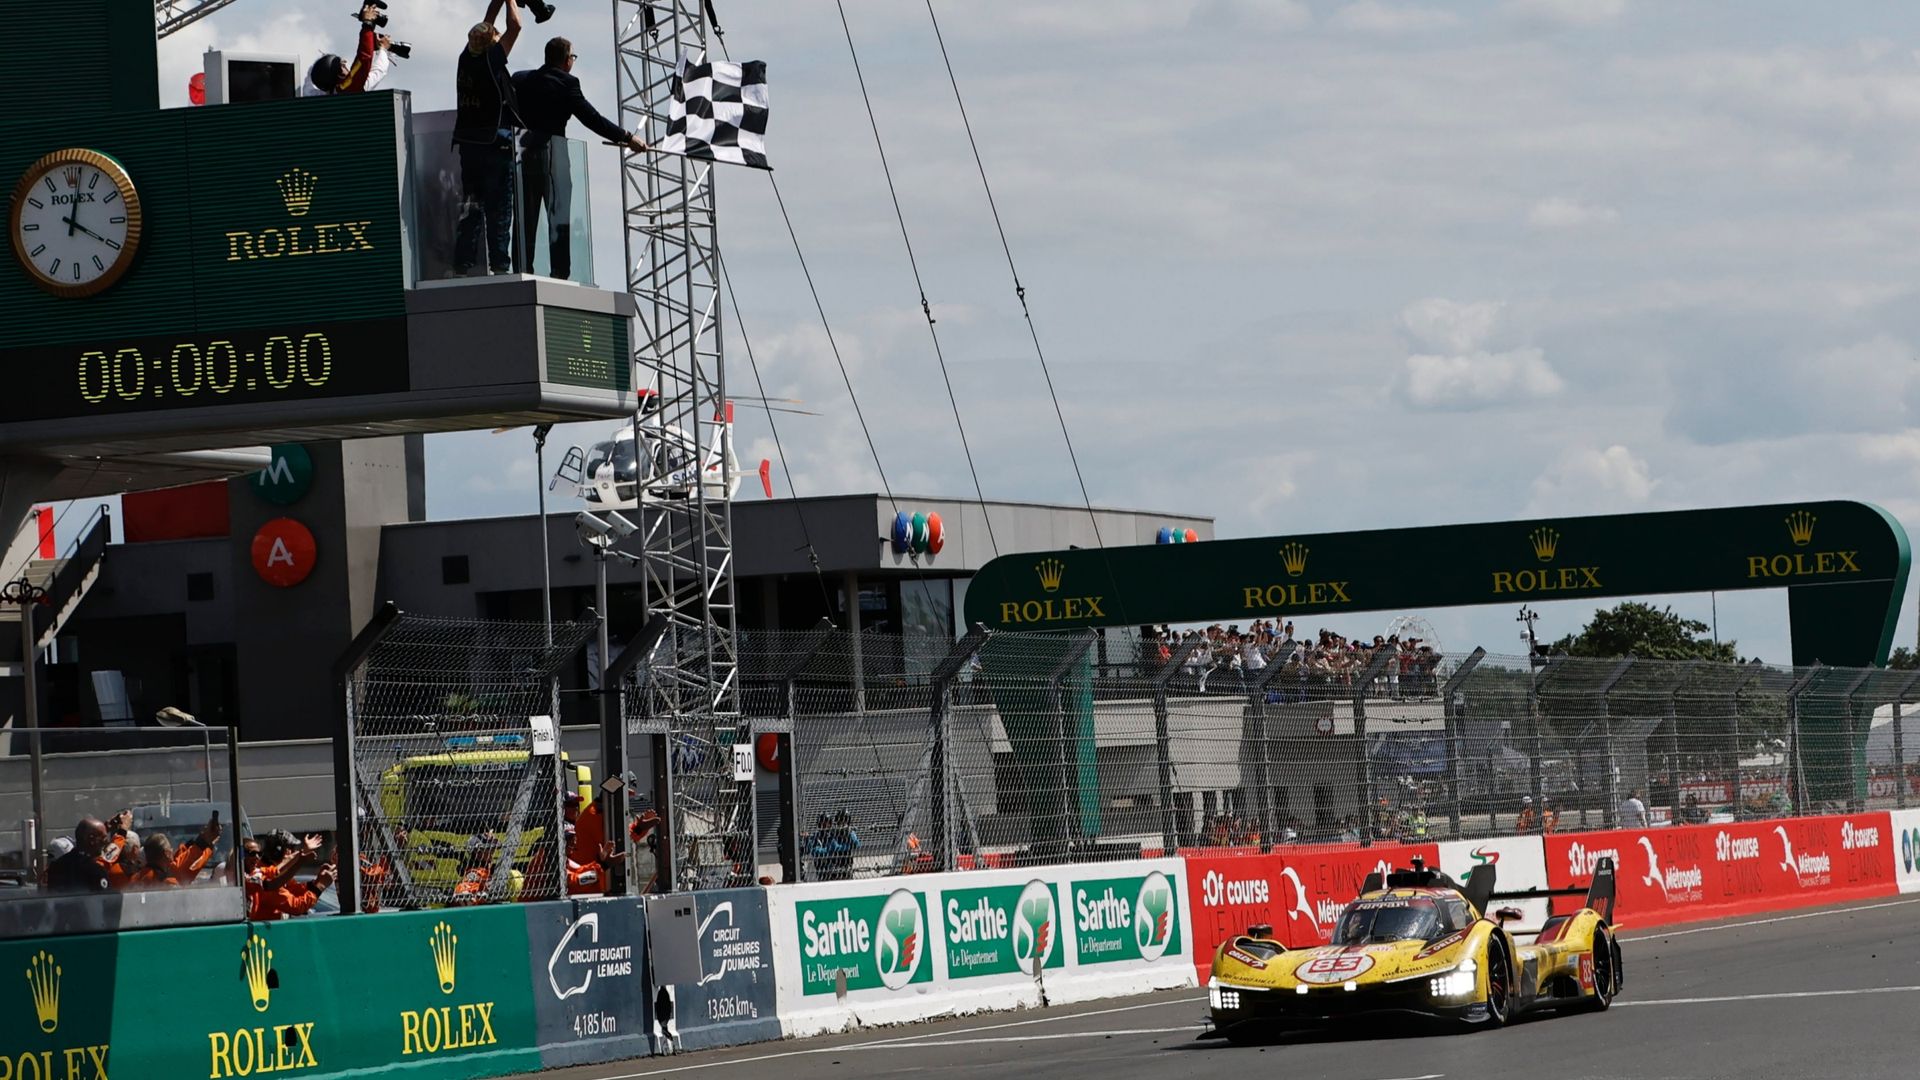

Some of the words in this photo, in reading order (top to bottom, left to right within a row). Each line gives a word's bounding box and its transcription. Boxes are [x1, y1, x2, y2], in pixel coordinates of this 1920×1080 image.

[51, 192, 96, 206] ROLEX
[226, 221, 374, 261] ROLEX
[78, 332, 332, 403] 00:00:00
[258, 455, 296, 487] M
[266, 535, 296, 568] A
[1746, 550, 1861, 579] ROLEX
[1491, 566, 1603, 594] ROLEX
[1243, 581, 1352, 609] ROLEX
[1000, 596, 1106, 624] ROLEX
[1226, 879, 1270, 905] course
[947, 897, 1008, 944] Sarthe
[1076, 887, 1131, 932] Sarthe
[713, 928, 740, 942] CIRCUIT
[803, 907, 870, 958] Sarthe
[1080, 937, 1089, 954] Le
[1088, 936, 1123, 957] Département
[569, 948, 599, 964] CIRCUIT
[600, 945, 632, 961] BUGATTI
[713, 948, 722, 957] DES
[951, 949, 961, 967] Le
[960, 948, 999, 970] Département
[1312, 958, 1361, 972] 83
[597, 964, 607, 978] LE
[606, 961, 632, 977] MANS
[806, 964, 817, 983] Le
[1582, 959, 1592, 983] 83
[707, 996, 735, 1021] 13,626
[735, 995, 750, 1016] km
[401, 1002, 497, 1056] ROLEX
[573, 1013, 600, 1039] 4,185
[601, 1010, 616, 1033] km
[208, 1022, 319, 1079] ROLEX
